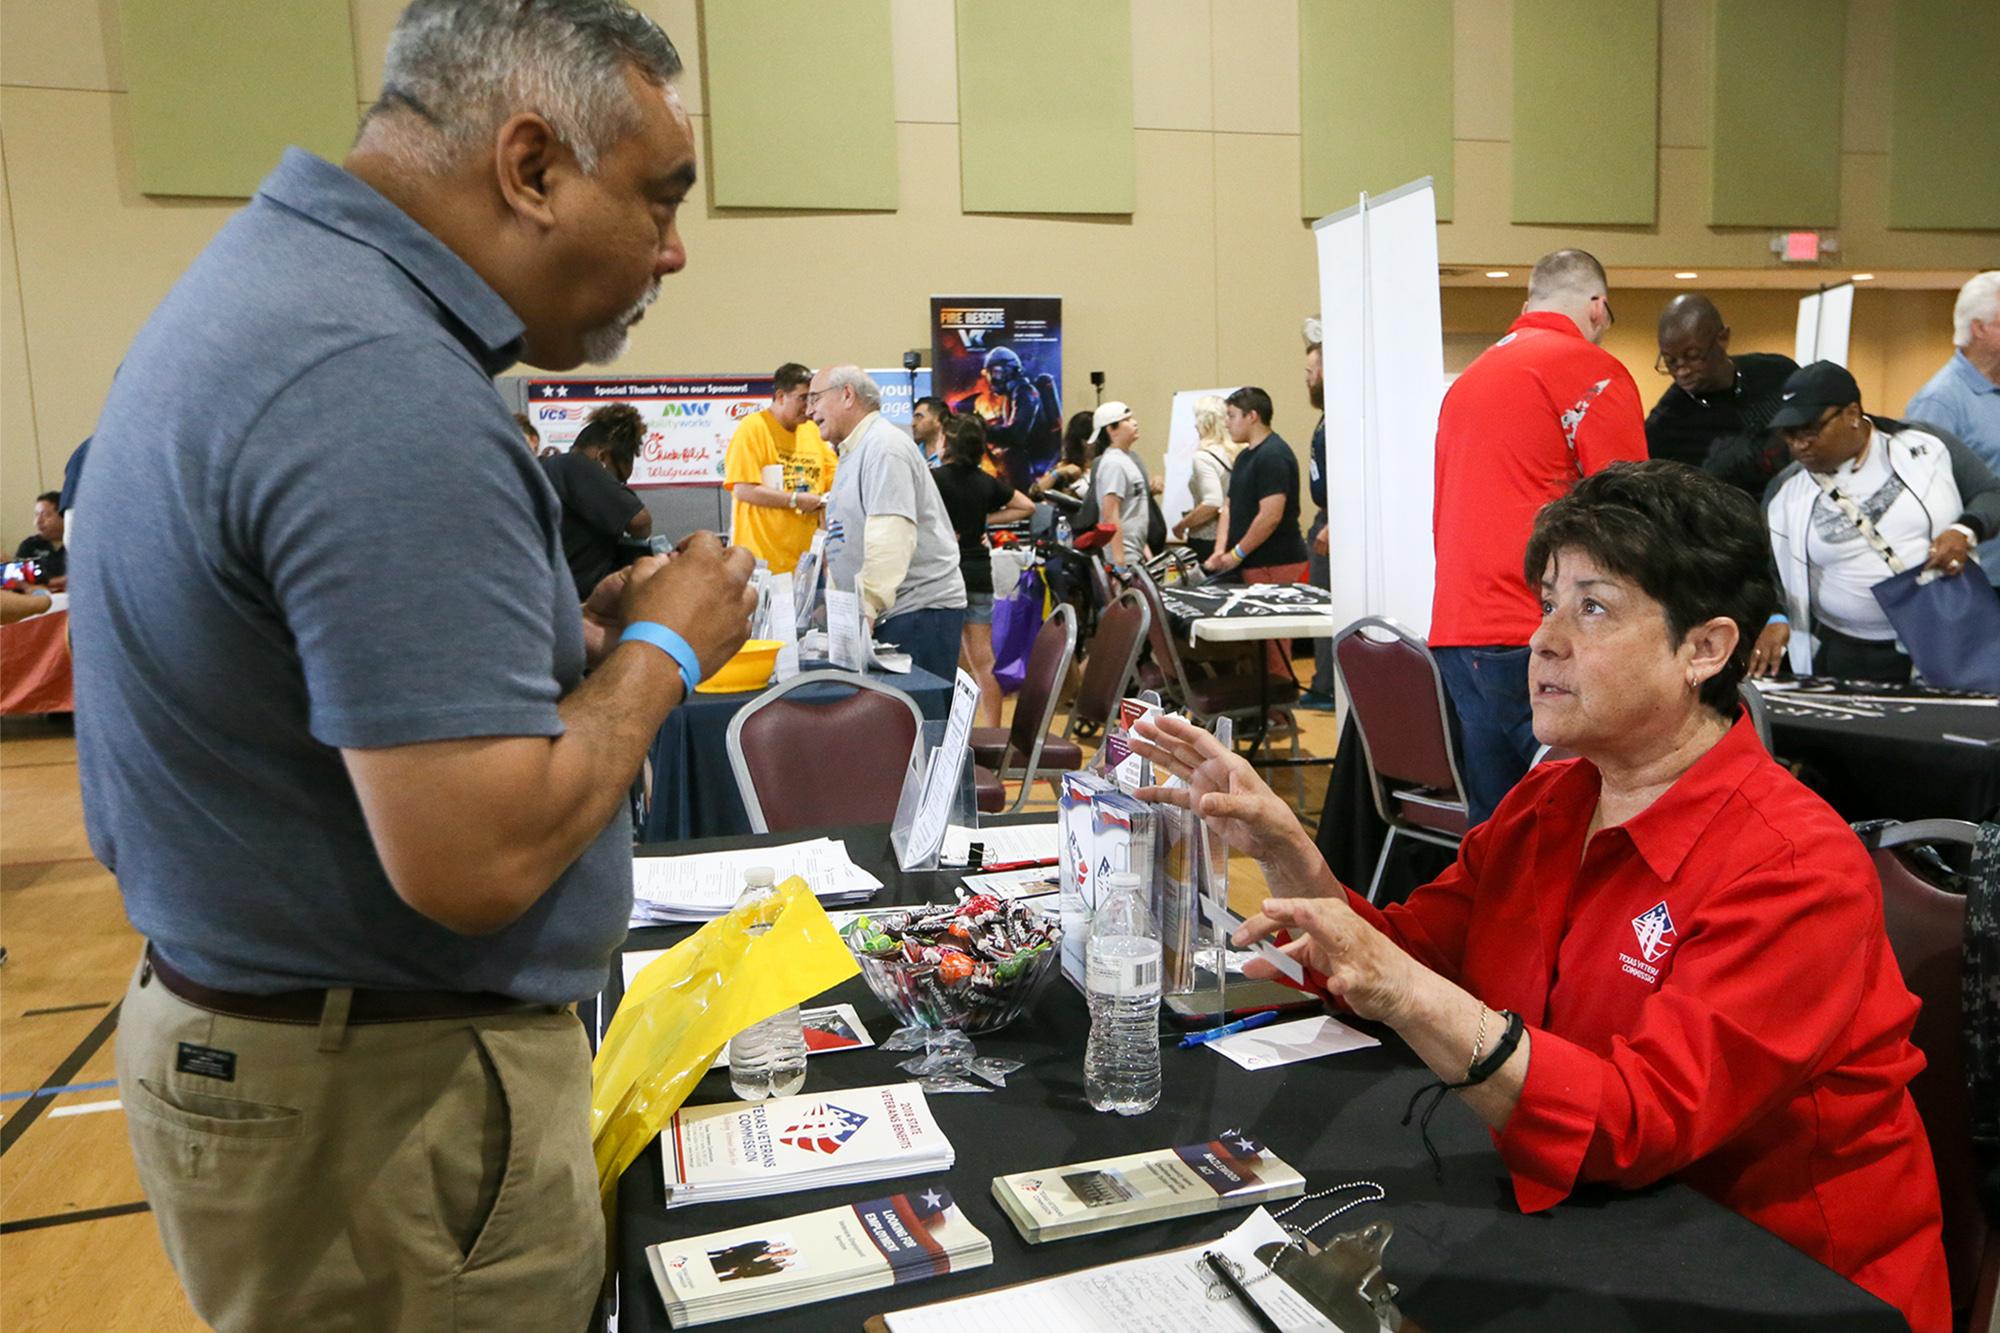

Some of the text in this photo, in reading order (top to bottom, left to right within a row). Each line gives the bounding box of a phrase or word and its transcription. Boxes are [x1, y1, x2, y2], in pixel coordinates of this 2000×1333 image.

[940, 312, 1005, 324] FIRE RESCUE
[594, 384, 748, 395] Special Thank You to our Sponsors!
[539, 409, 567, 420] VCS
[881, 1089, 912, 1149] VETERANS BENEFITS
[906, 1117, 922, 1135] STATE
[738, 1113, 759, 1163] COMMISSION
[752, 1103, 776, 1168] TEXAS VETERANS
[1198, 1166, 1215, 1175] ACT
[864, 1212, 900, 1252] EMPLOYMENT
[882, 1209, 917, 1248] LOOKING FOR
